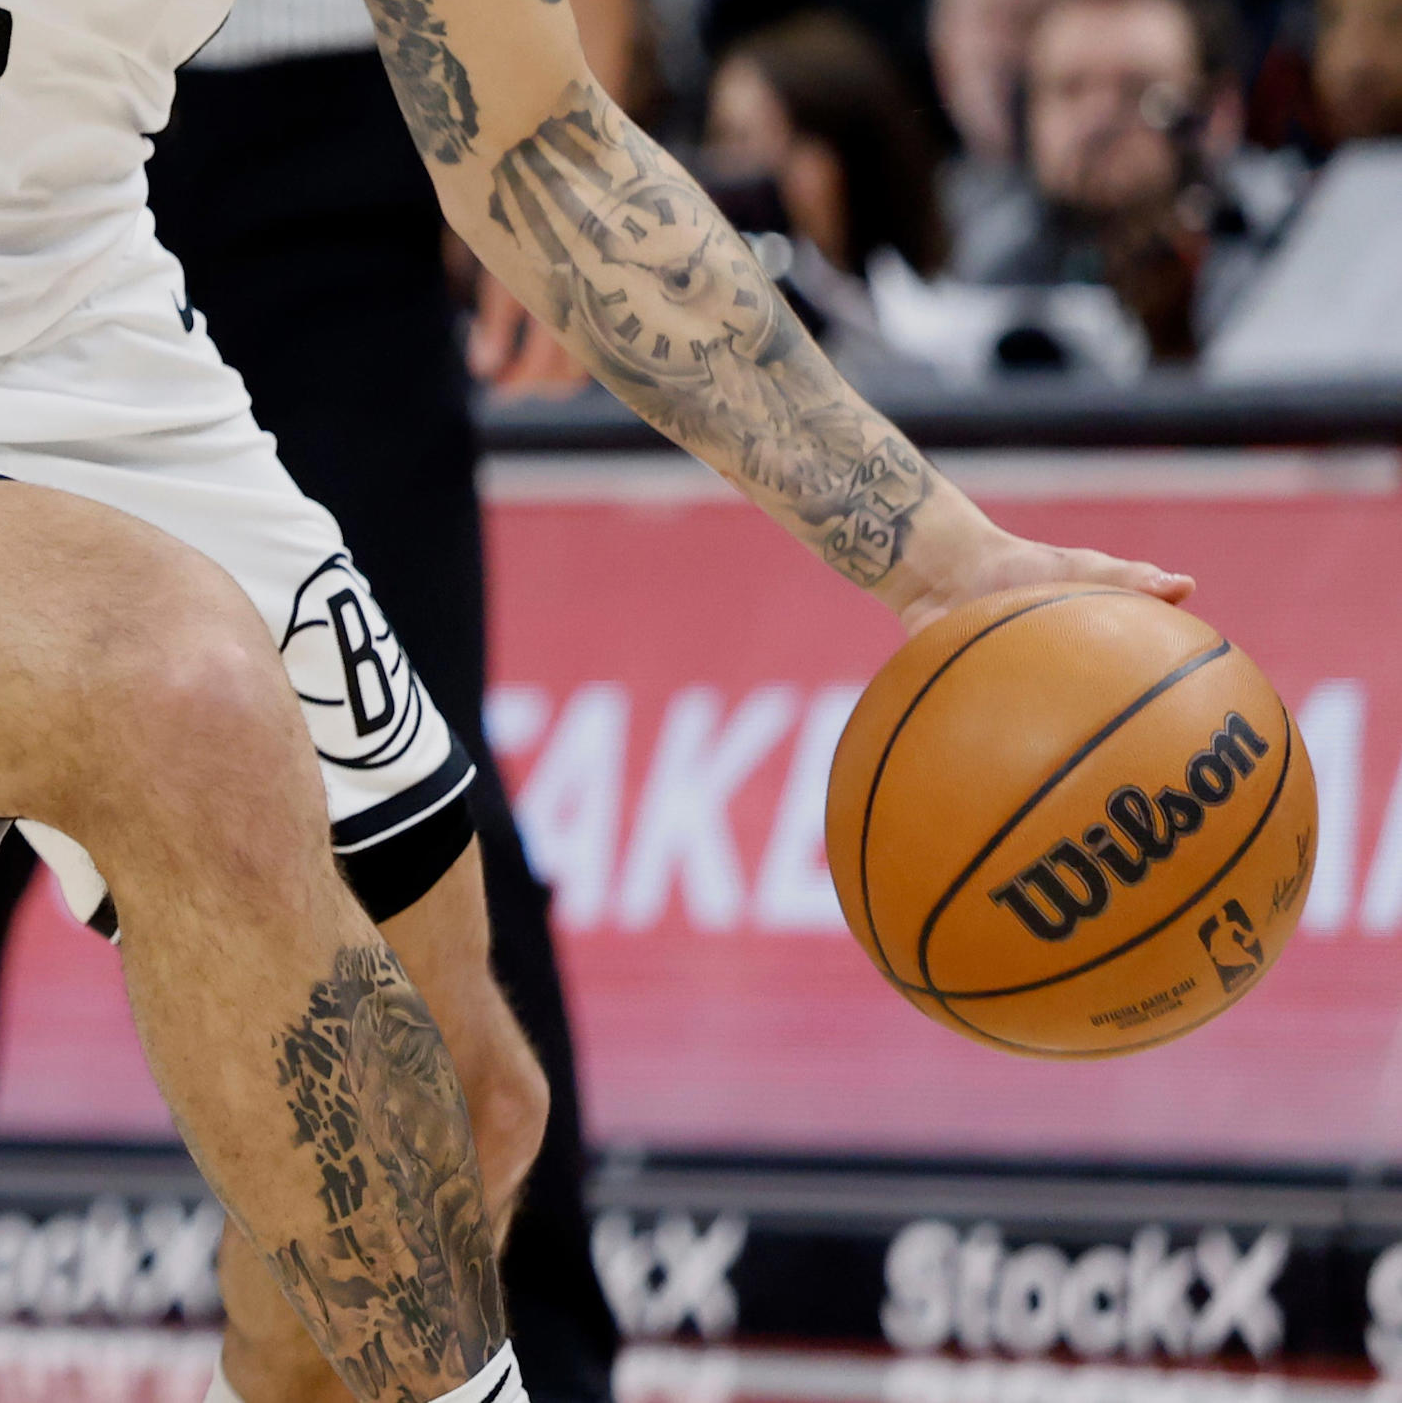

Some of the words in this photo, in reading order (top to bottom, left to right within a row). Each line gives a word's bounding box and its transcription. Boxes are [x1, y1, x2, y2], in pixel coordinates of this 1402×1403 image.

[327, 588, 395, 738] B
[988, 711, 1270, 944] Wilson
[881, 1220, 1289, 1355] StockX
